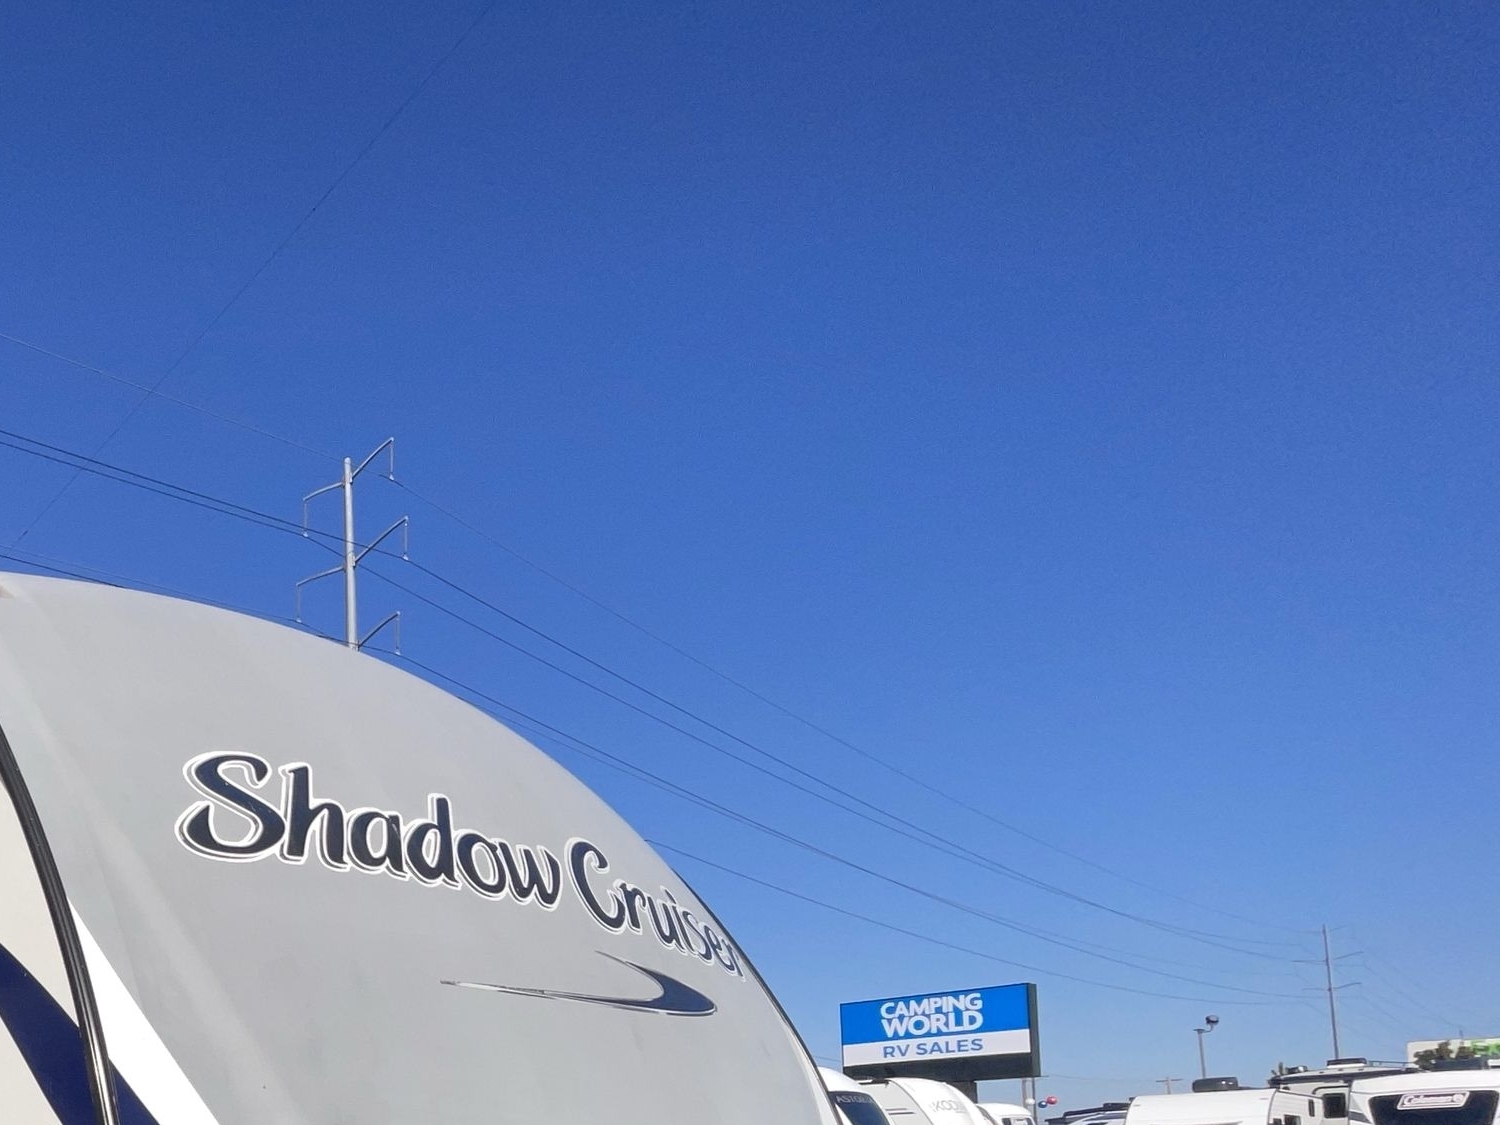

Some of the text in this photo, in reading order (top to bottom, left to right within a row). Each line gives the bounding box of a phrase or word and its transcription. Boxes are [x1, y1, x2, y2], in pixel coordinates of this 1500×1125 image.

[175, 751, 747, 982] Shadow Cruiser
[880, 993, 983, 1019] CAMPING
[881, 1010, 984, 1038] WORLD
[883, 1038, 984, 1058] RV SALES
